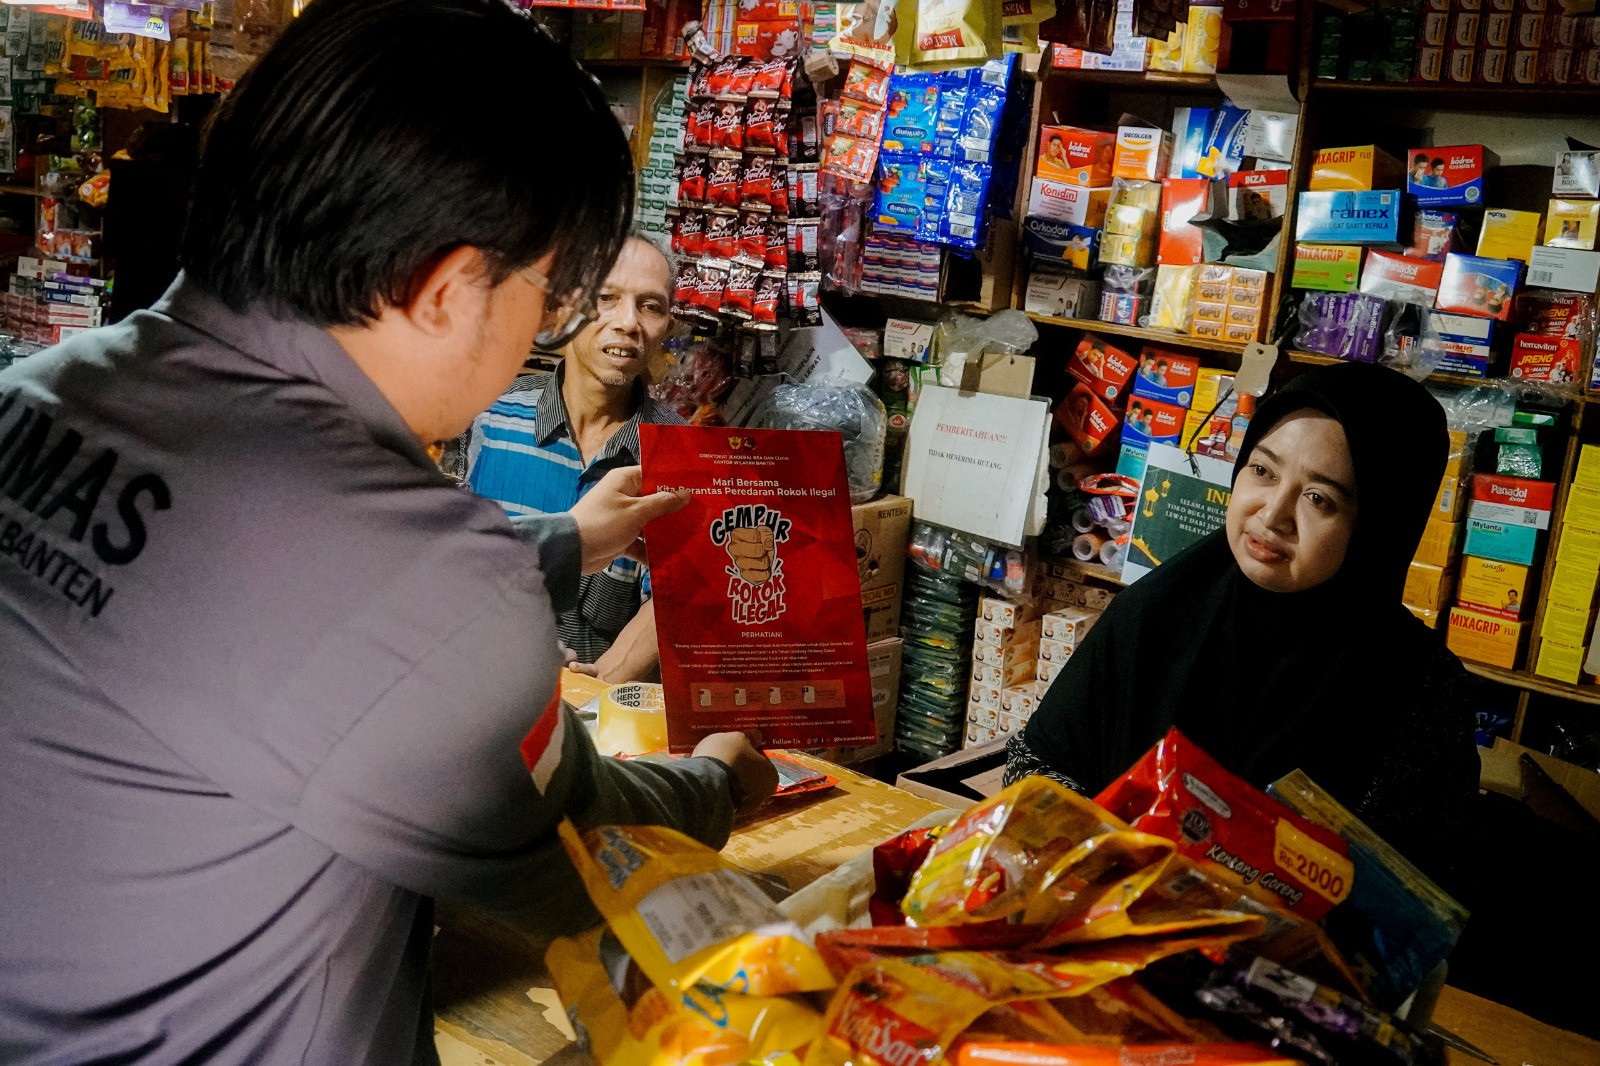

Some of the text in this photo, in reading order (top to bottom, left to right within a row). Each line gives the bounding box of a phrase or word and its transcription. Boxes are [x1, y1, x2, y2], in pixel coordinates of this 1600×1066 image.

[1040, 182, 1078, 202] Konidin
[1330, 208, 1389, 219] ramex
[1197, 326, 1219, 336] GPU
[1229, 331, 1252, 341] GPU
[1520, 340, 1558, 351] hemaviton
[1518, 354, 1554, 365] JRENG
[1126, 447, 1146, 458] Mylant
[929, 449, 1002, 470] TIDAK MENERIMA HUTANG
[712, 478, 779, 487] Mari Bersama
[725, 487, 776, 496] Peredaran
[778, 488, 807, 497] Rokok
[810, 488, 836, 498] Ilegal
[1491, 484, 1528, 498] Panadol
[878, 507, 908, 519] BENTENG
[1180, 498, 1227, 517] SELAMA BULA
[1165, 511, 1188, 523] LEWAT
[1189, 517, 1206, 527] DARI
[1167, 503, 1226, 525] TOKO BUKA PUKU
[711, 504, 792, 546] GEMPUR
[1473, 520, 1502, 532] Mylanta
[2, 521, 114, 618] BANTEN
[727, 573, 786, 604] ROKOK
[861, 590, 884, 601] PECIAL
[732, 594, 786, 625] ILEGAL
[1450, 612, 1516, 637] MIXAGRIP FLU
[741, 631, 783, 639] PERHATIAN!
[617, 685, 641, 695] HERO
[617, 692, 641, 703] HERO
[620, 700, 640, 708] ERO
[1205, 842, 1303, 905] Kentang Goreng
[1297, 853, 1344, 898] 2000
